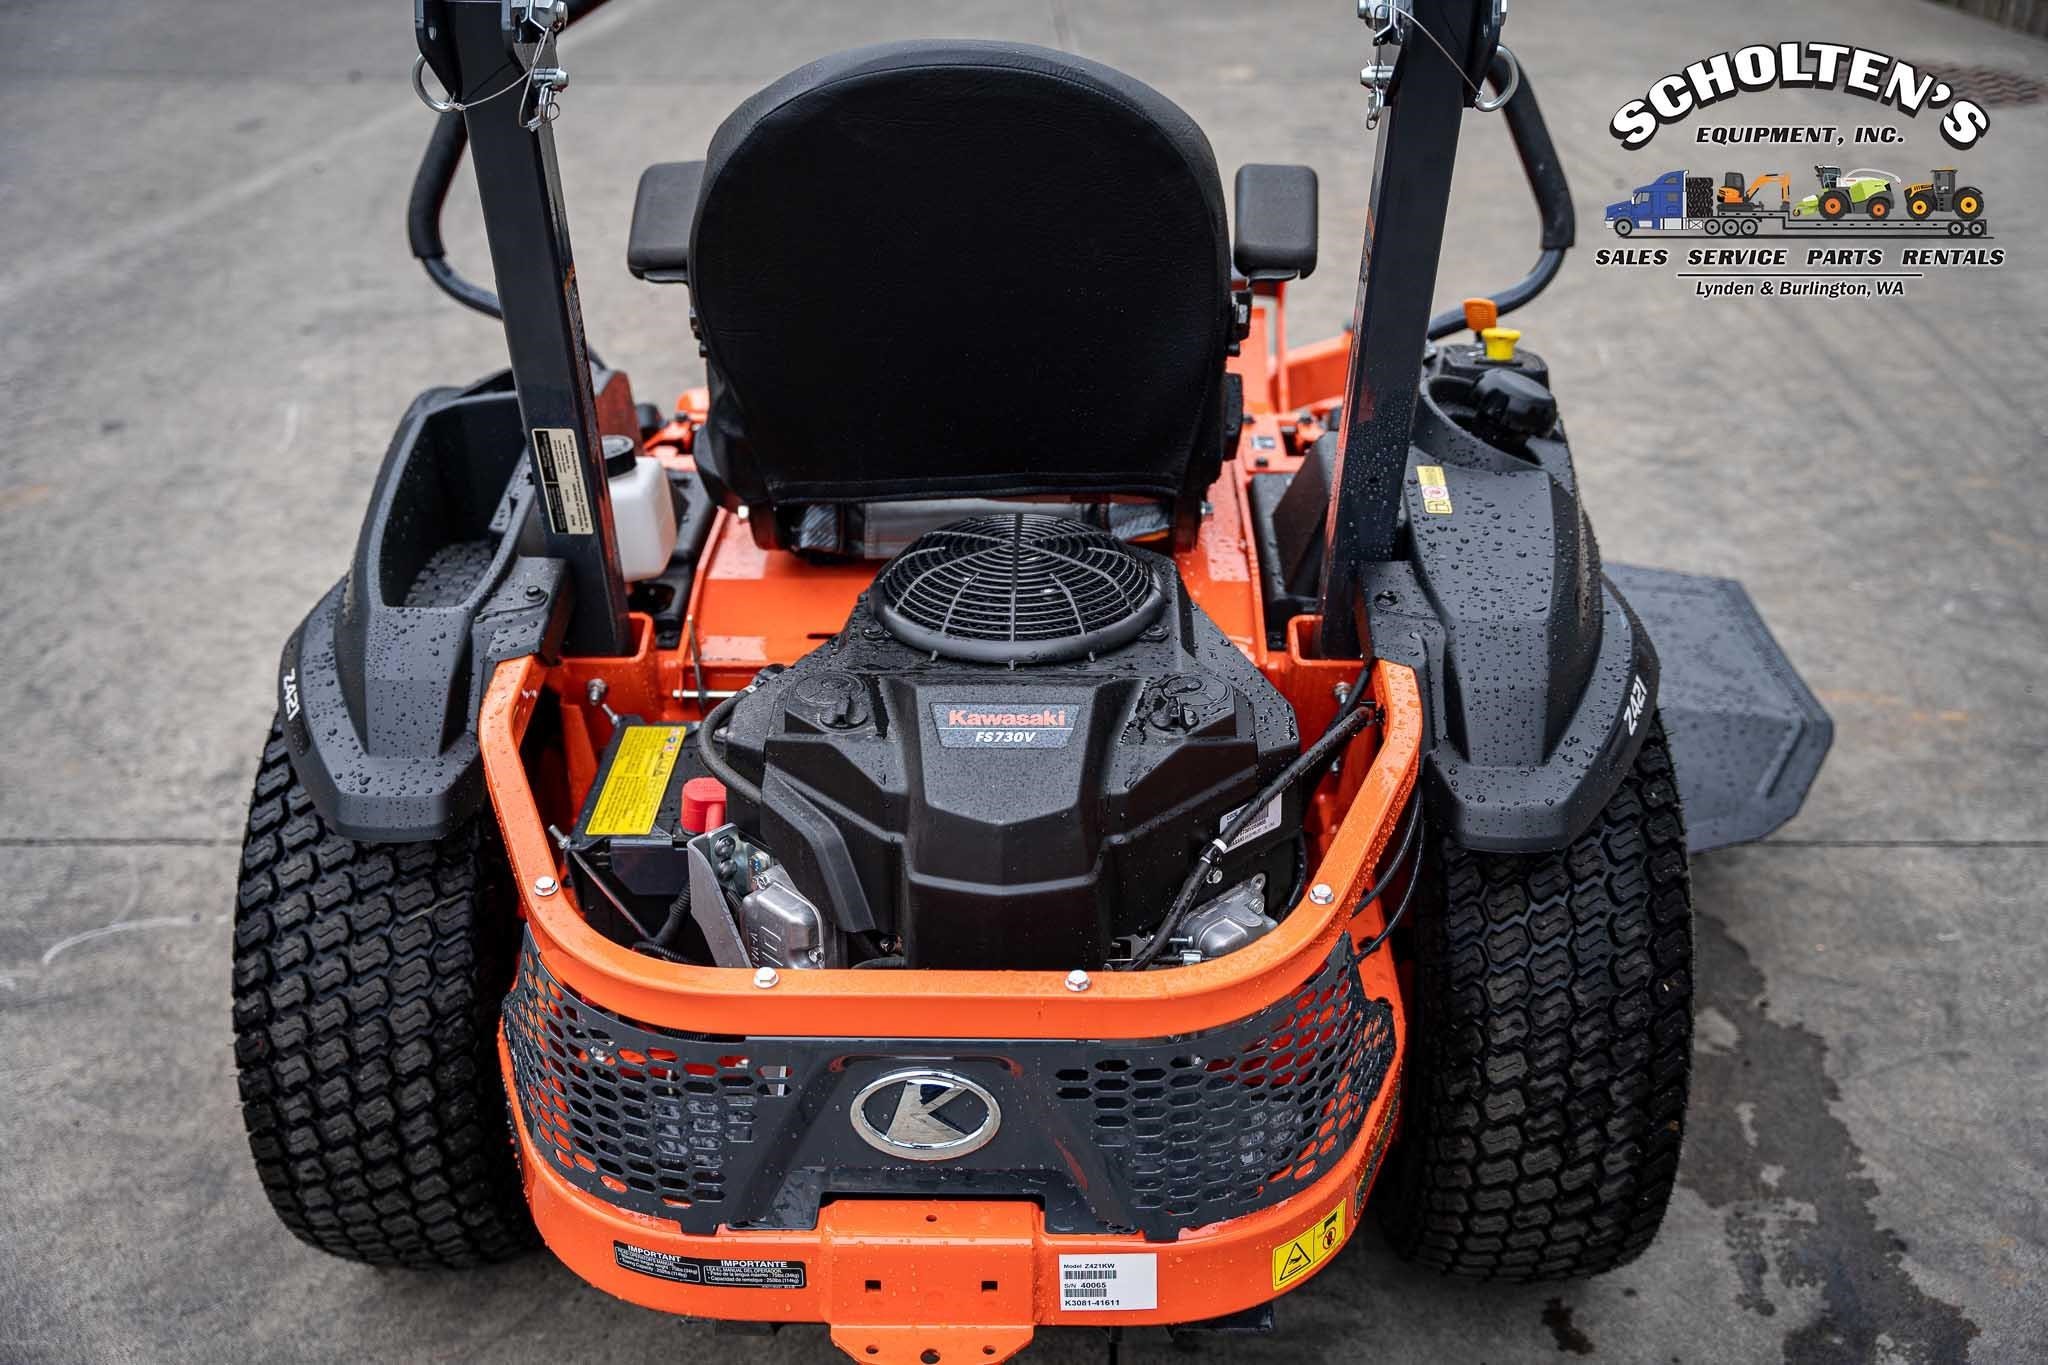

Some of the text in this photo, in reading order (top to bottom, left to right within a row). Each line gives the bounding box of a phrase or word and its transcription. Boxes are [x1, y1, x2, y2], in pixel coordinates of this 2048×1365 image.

[948, 709, 1066, 727] Kawasaki
[975, 731, 1037, 743] FS730V
[627, 1245, 681, 1262] IMPORTANT
[720, 1260, 788, 1268] IMPORTANTE
